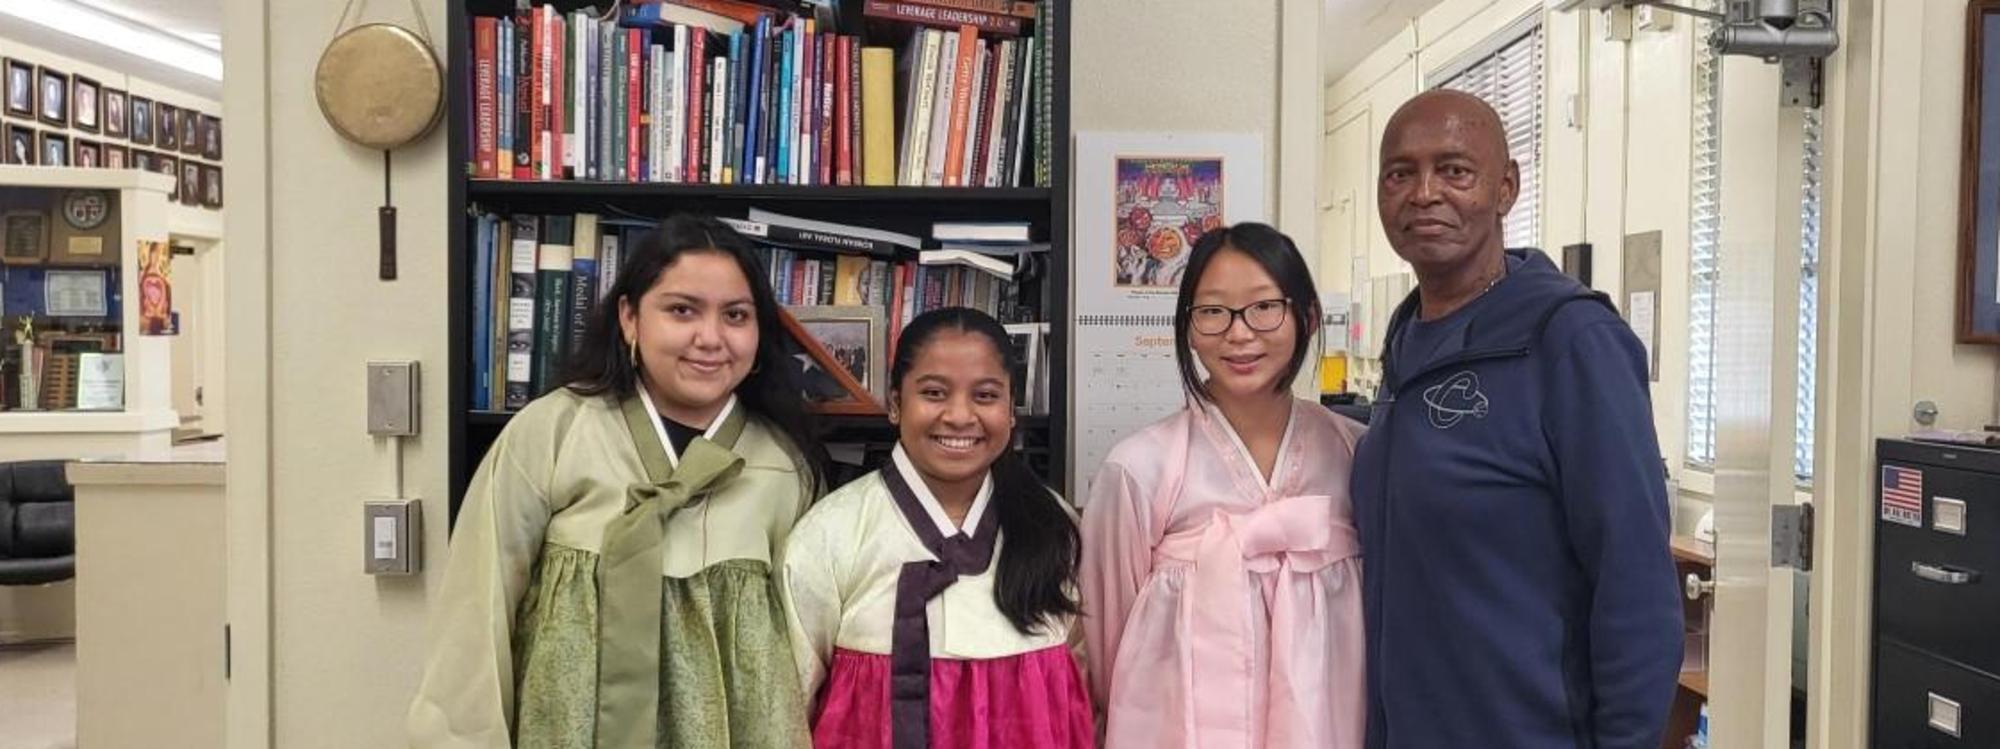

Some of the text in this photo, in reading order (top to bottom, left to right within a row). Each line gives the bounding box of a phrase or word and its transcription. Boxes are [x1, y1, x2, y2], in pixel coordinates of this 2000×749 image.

[896, 3, 936, 19] LEVERAGE
[938, 7, 988, 27] LEADERSHIP
[479, 59, 492, 152] LEVERAGE LEADERSHIP
[822, 82, 832, 117] Notice
[814, 234, 841, 245] FLORAL
[842, 238, 873, 249] KOREAN
[574, 275, 588, 310] Medal
[574, 313, 586, 327] of
